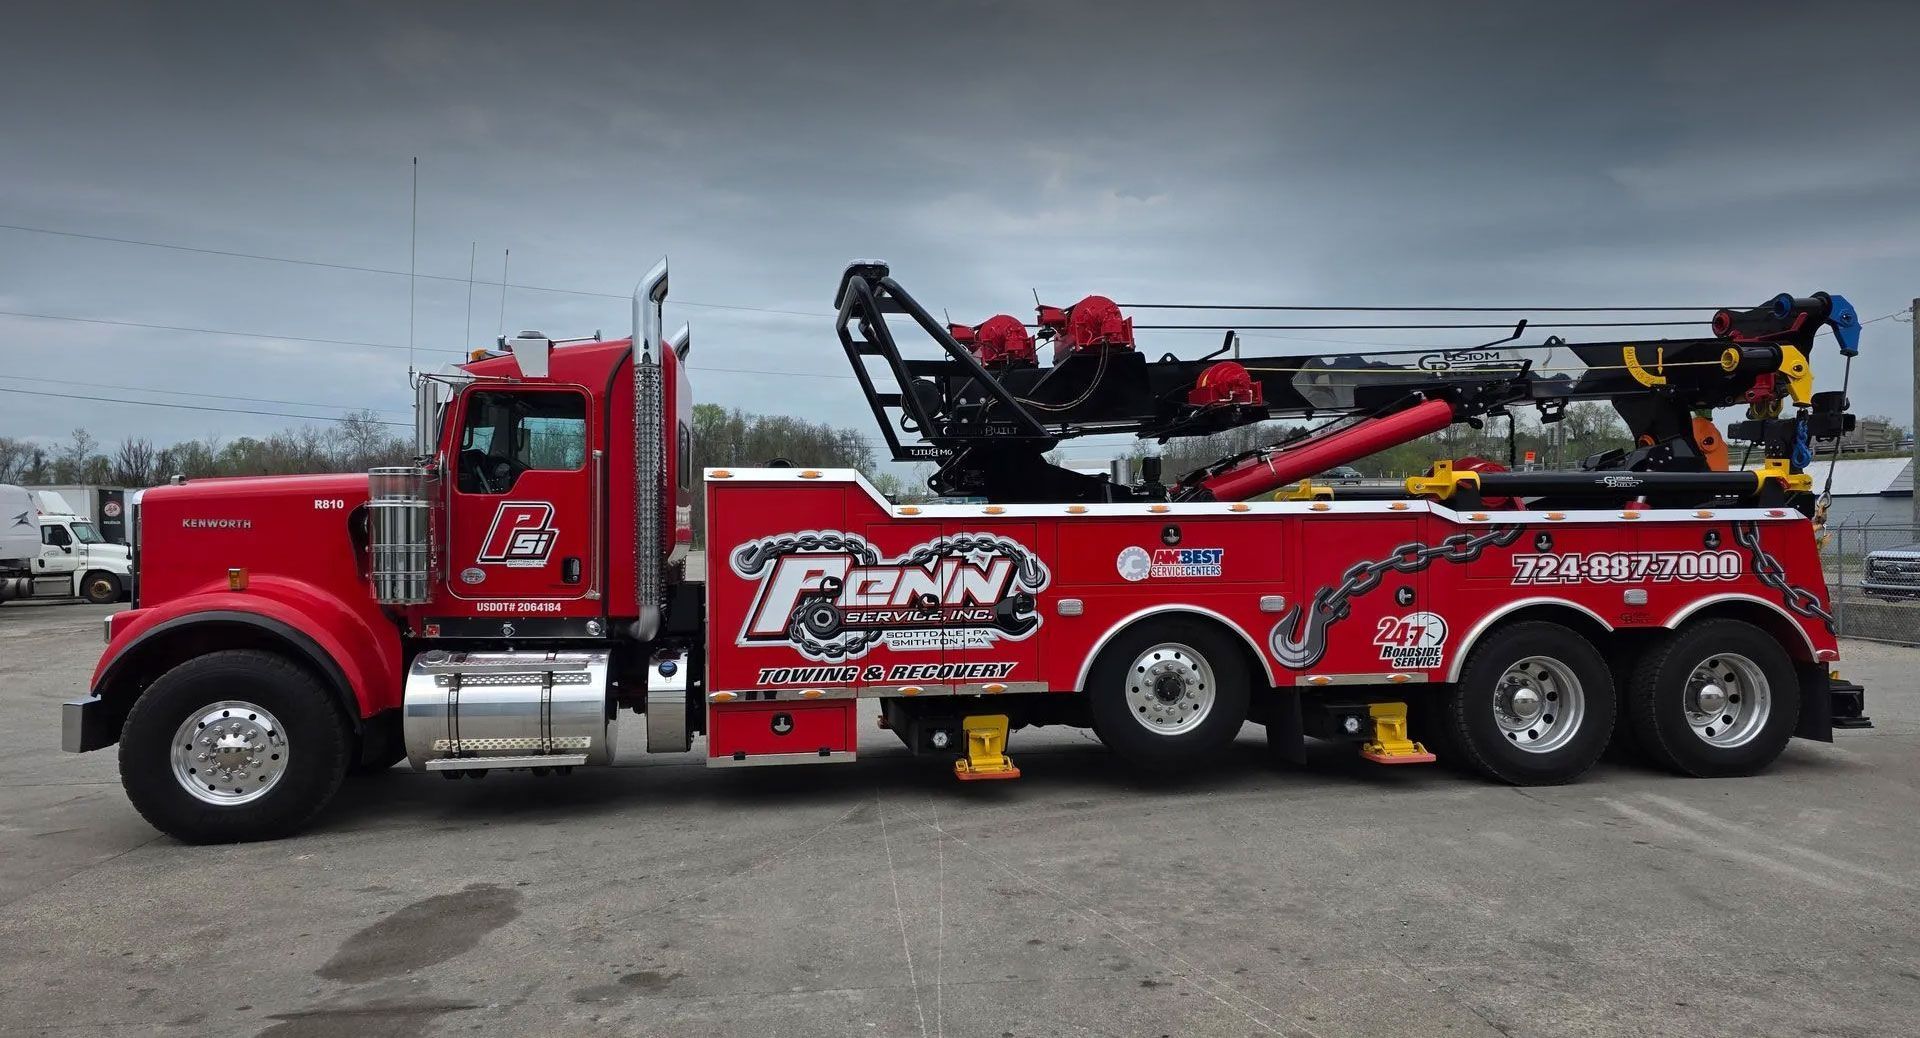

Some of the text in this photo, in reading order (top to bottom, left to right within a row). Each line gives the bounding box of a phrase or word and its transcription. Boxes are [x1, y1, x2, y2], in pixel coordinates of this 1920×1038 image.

[314, 499, 345, 509] R810
[182, 518, 251, 529] KENWORTH
[477, 602, 561, 612] USDOT# 2064184
[950, 609, 993, 621] INC.
[886, 629, 990, 639] SCOTTDALE PA
[892, 637, 984, 646] SMITHTON PA
[1382, 645, 1441, 658] ROADSIDE
[1393, 656, 1441, 667] SERVICE
[757, 661, 1018, 685] TOWING & RECOVERY
